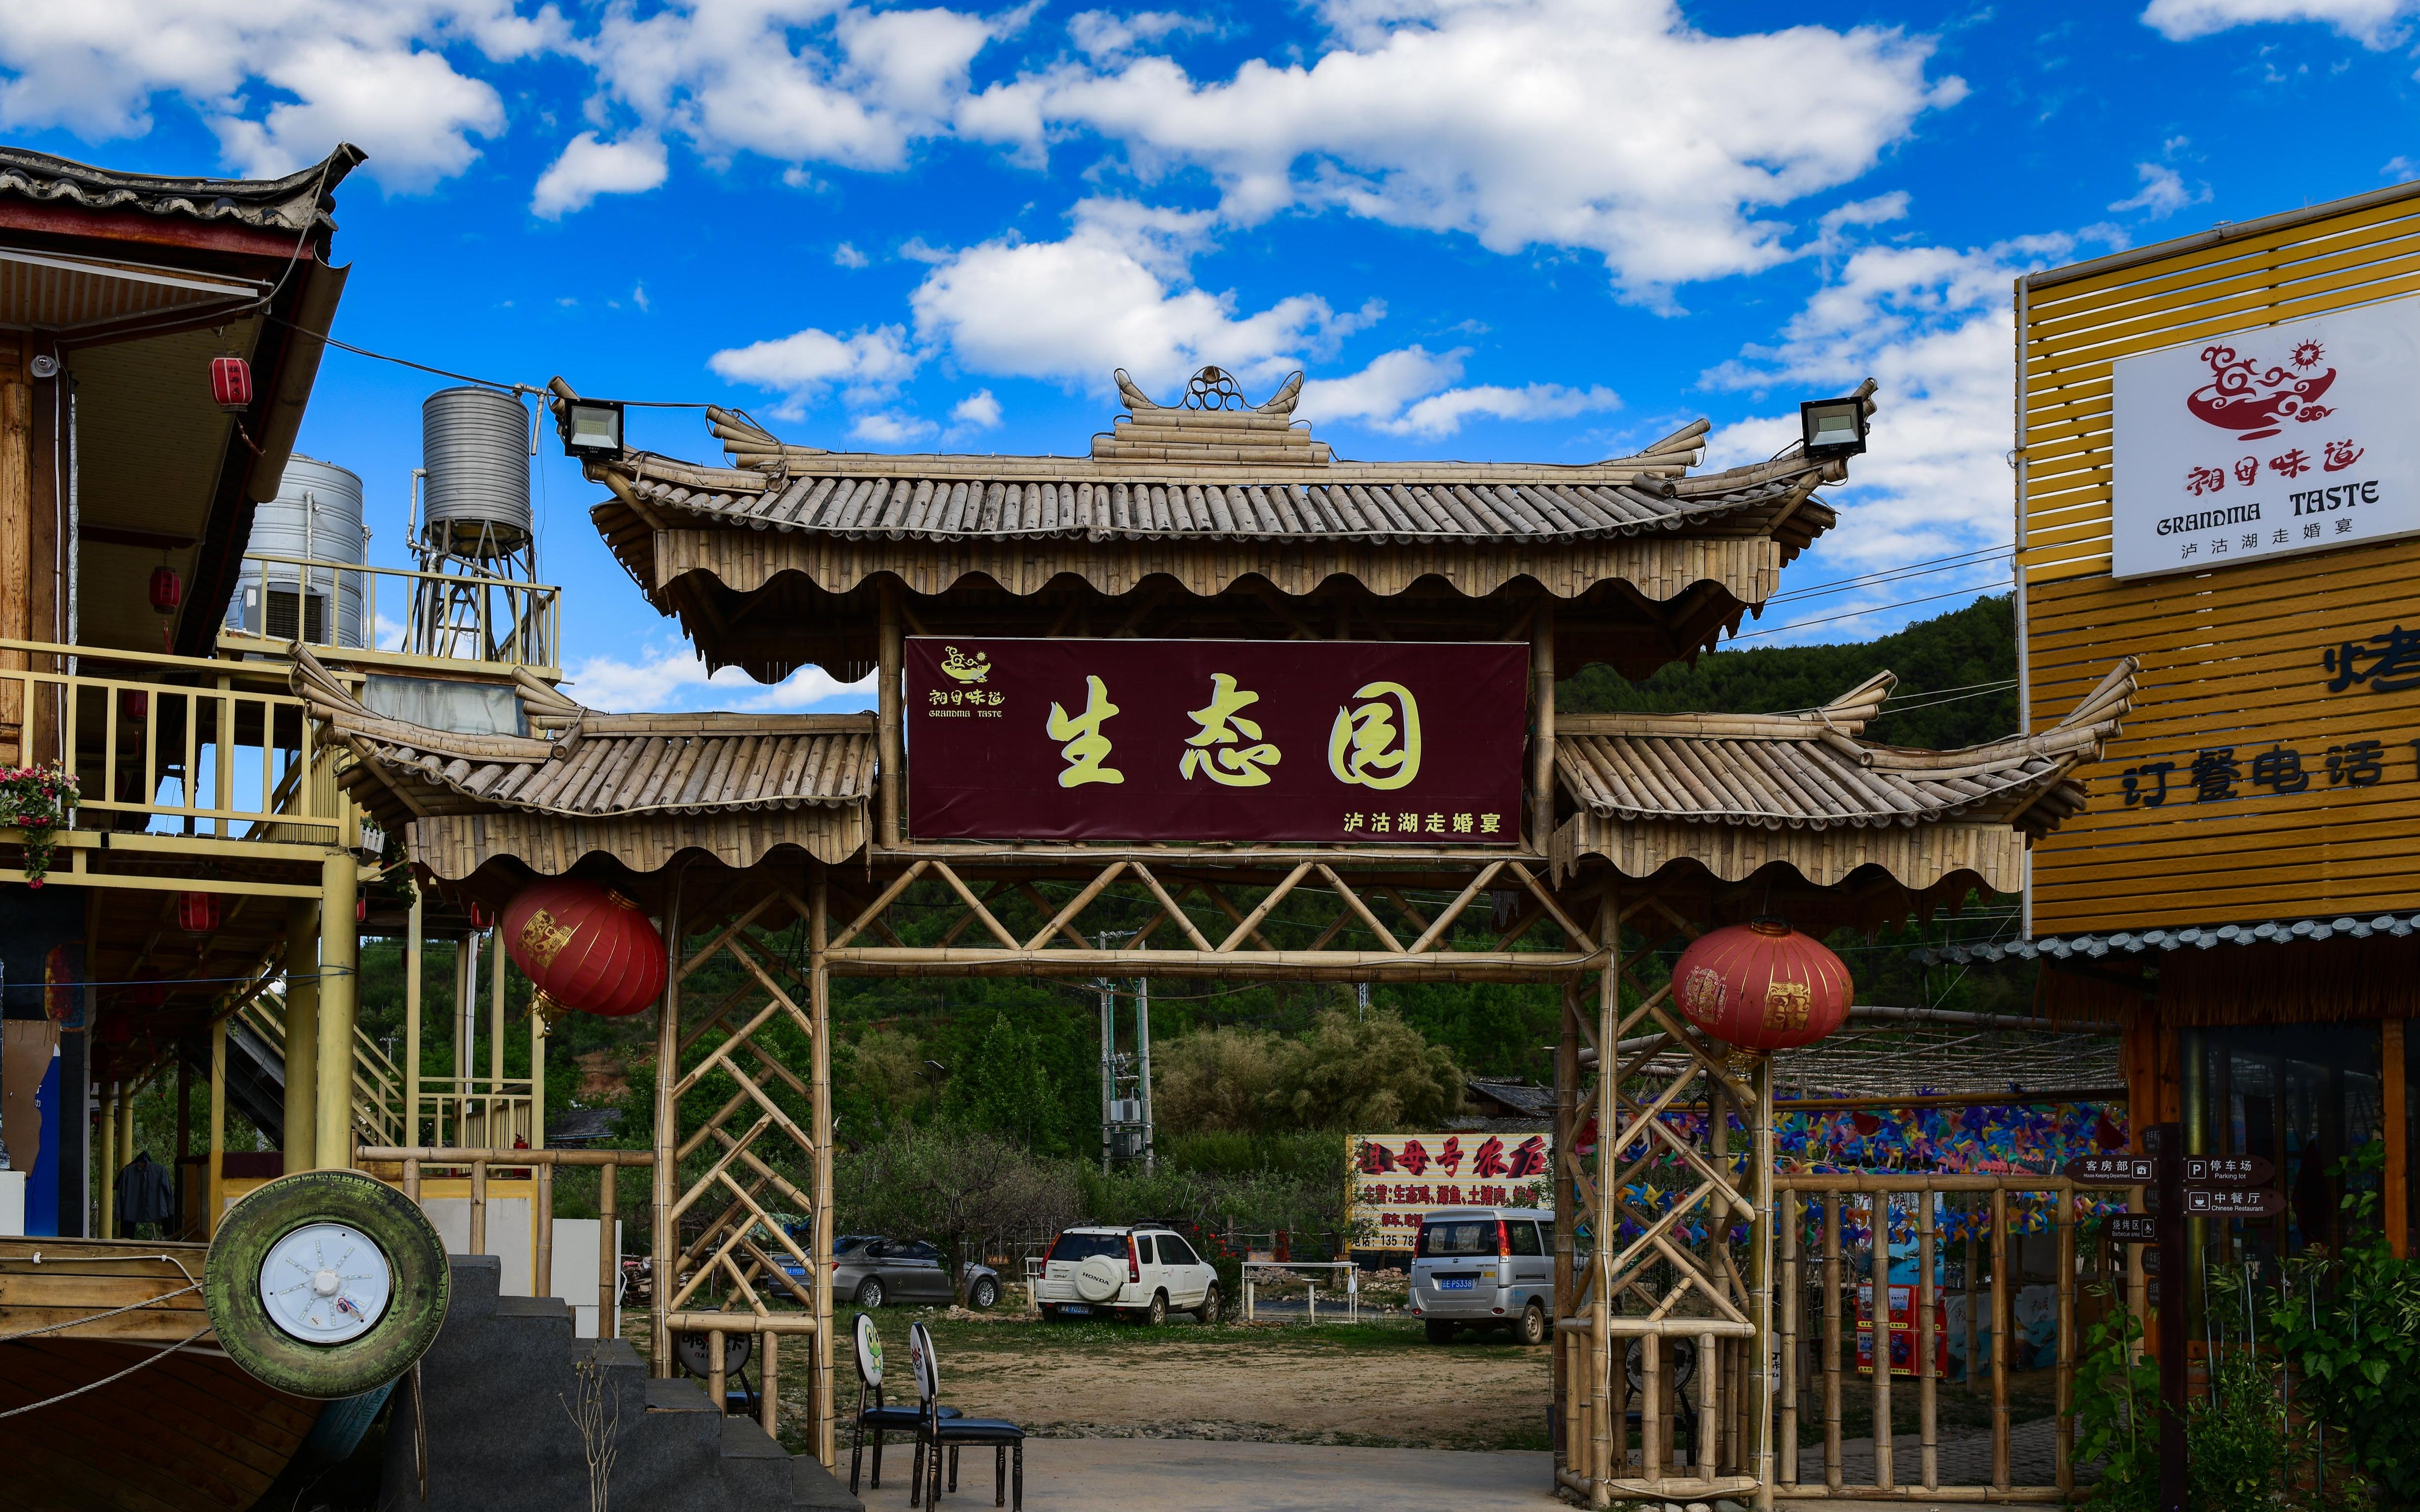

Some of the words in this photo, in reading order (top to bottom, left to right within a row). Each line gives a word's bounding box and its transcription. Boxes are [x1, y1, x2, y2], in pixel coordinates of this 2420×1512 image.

[2186, 438, 2365, 496] 祖母味道
[2157, 503, 2261, 536] GRANDMA
[2290, 480, 2380, 517] TASTE
[2181, 517, 2353, 559] 泸沽湖走婚宴
[929, 688, 1005, 706] 祖母味道
[1046, 673, 1423, 790] 生态园
[2122, 740, 2384, 807] 订餐电话
[1344, 811, 1501, 833] 泸沽湖走婚宴
[1357, 1135, 1548, 1179] 祖母号农庄
[2086, 1159, 2129, 1172] 客房部
[2210, 1159, 2252, 1171] 停车场
[2215, 1192, 2260, 1204] 中餐厅
[2112, 1219, 2139, 1230] 烧烤区
[1381, 1235, 1397, 1246] 135
[1082, 1272, 1109, 1285] HONDA
